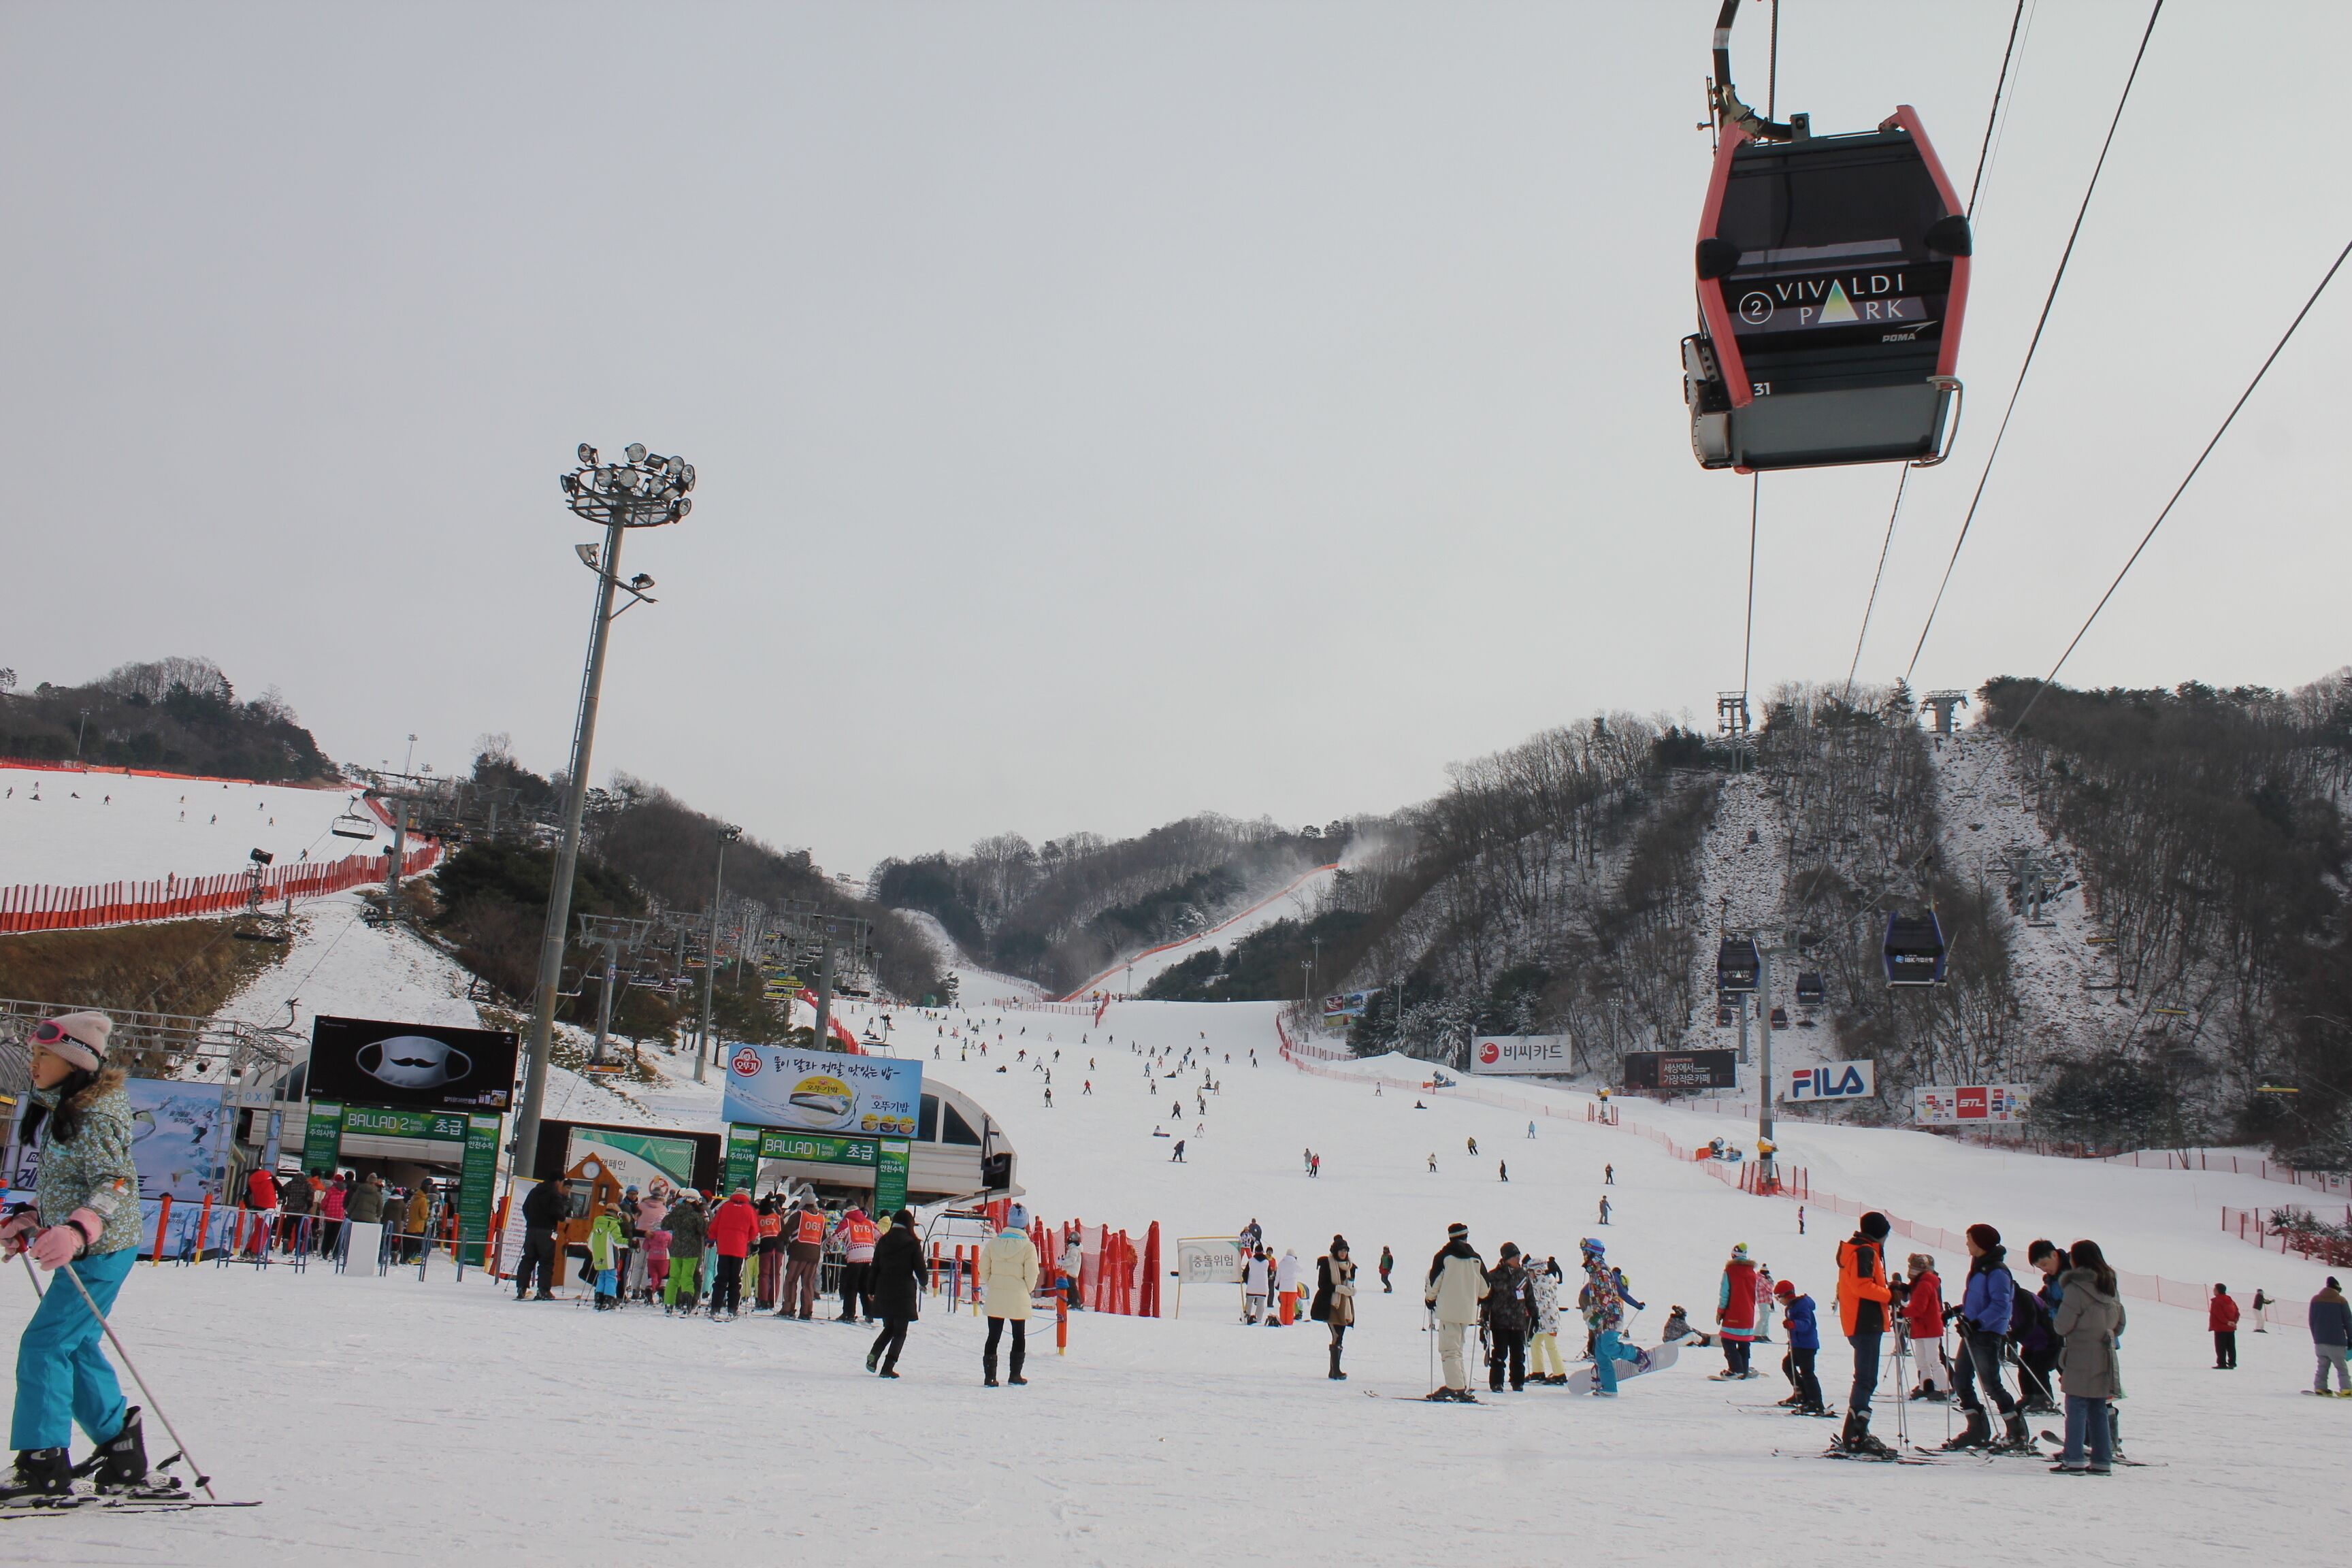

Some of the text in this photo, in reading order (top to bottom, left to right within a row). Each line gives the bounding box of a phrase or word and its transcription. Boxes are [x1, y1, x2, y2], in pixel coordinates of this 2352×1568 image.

[1776, 274, 1904, 301] VIVALDI
[1799, 299, 1904, 326] PARK
[1882, 331, 1916, 343] POMA
[1753, 382, 1771, 396] 31
[1480, 1043, 1495, 1058] BC
[1503, 1045, 1563, 1061] 비씨카드
[736, 1060, 757, 1072] 오뚜기
[774, 1056, 789, 1073] 물이
[794, 1057, 817, 1073] 달라
[821, 1062, 845, 1077] 정말
[848, 1064, 879, 1080] 맛있는
[1663, 1062, 1694, 1074] 세상에서
[1792, 1065, 1864, 1098] FILA
[806, 1085, 839, 1094] 오뚜기밥
[872, 1100, 910, 1113] 오뚜기밥
[1959, 1098, 1985, 1108] STL
[348, 1113, 409, 1131] BALLAD 2
[434, 1118, 463, 1136] 초급
[309, 1128, 337, 1139] 주의사항
[468, 1141, 494, 1150] 안전수칙
[765, 1139, 821, 1156] BALLAD 1
[846, 1144, 875, 1160] 초급
[730, 1152, 755, 1162] 주의사항
[880, 1164, 904, 1174] 안전수칙
[760, 1218, 777, 1227] 067
[804, 1221, 821, 1231] 065
[853, 1224, 870, 1233] 076
[1192, 1254, 1234, 1268] 충돌위험
